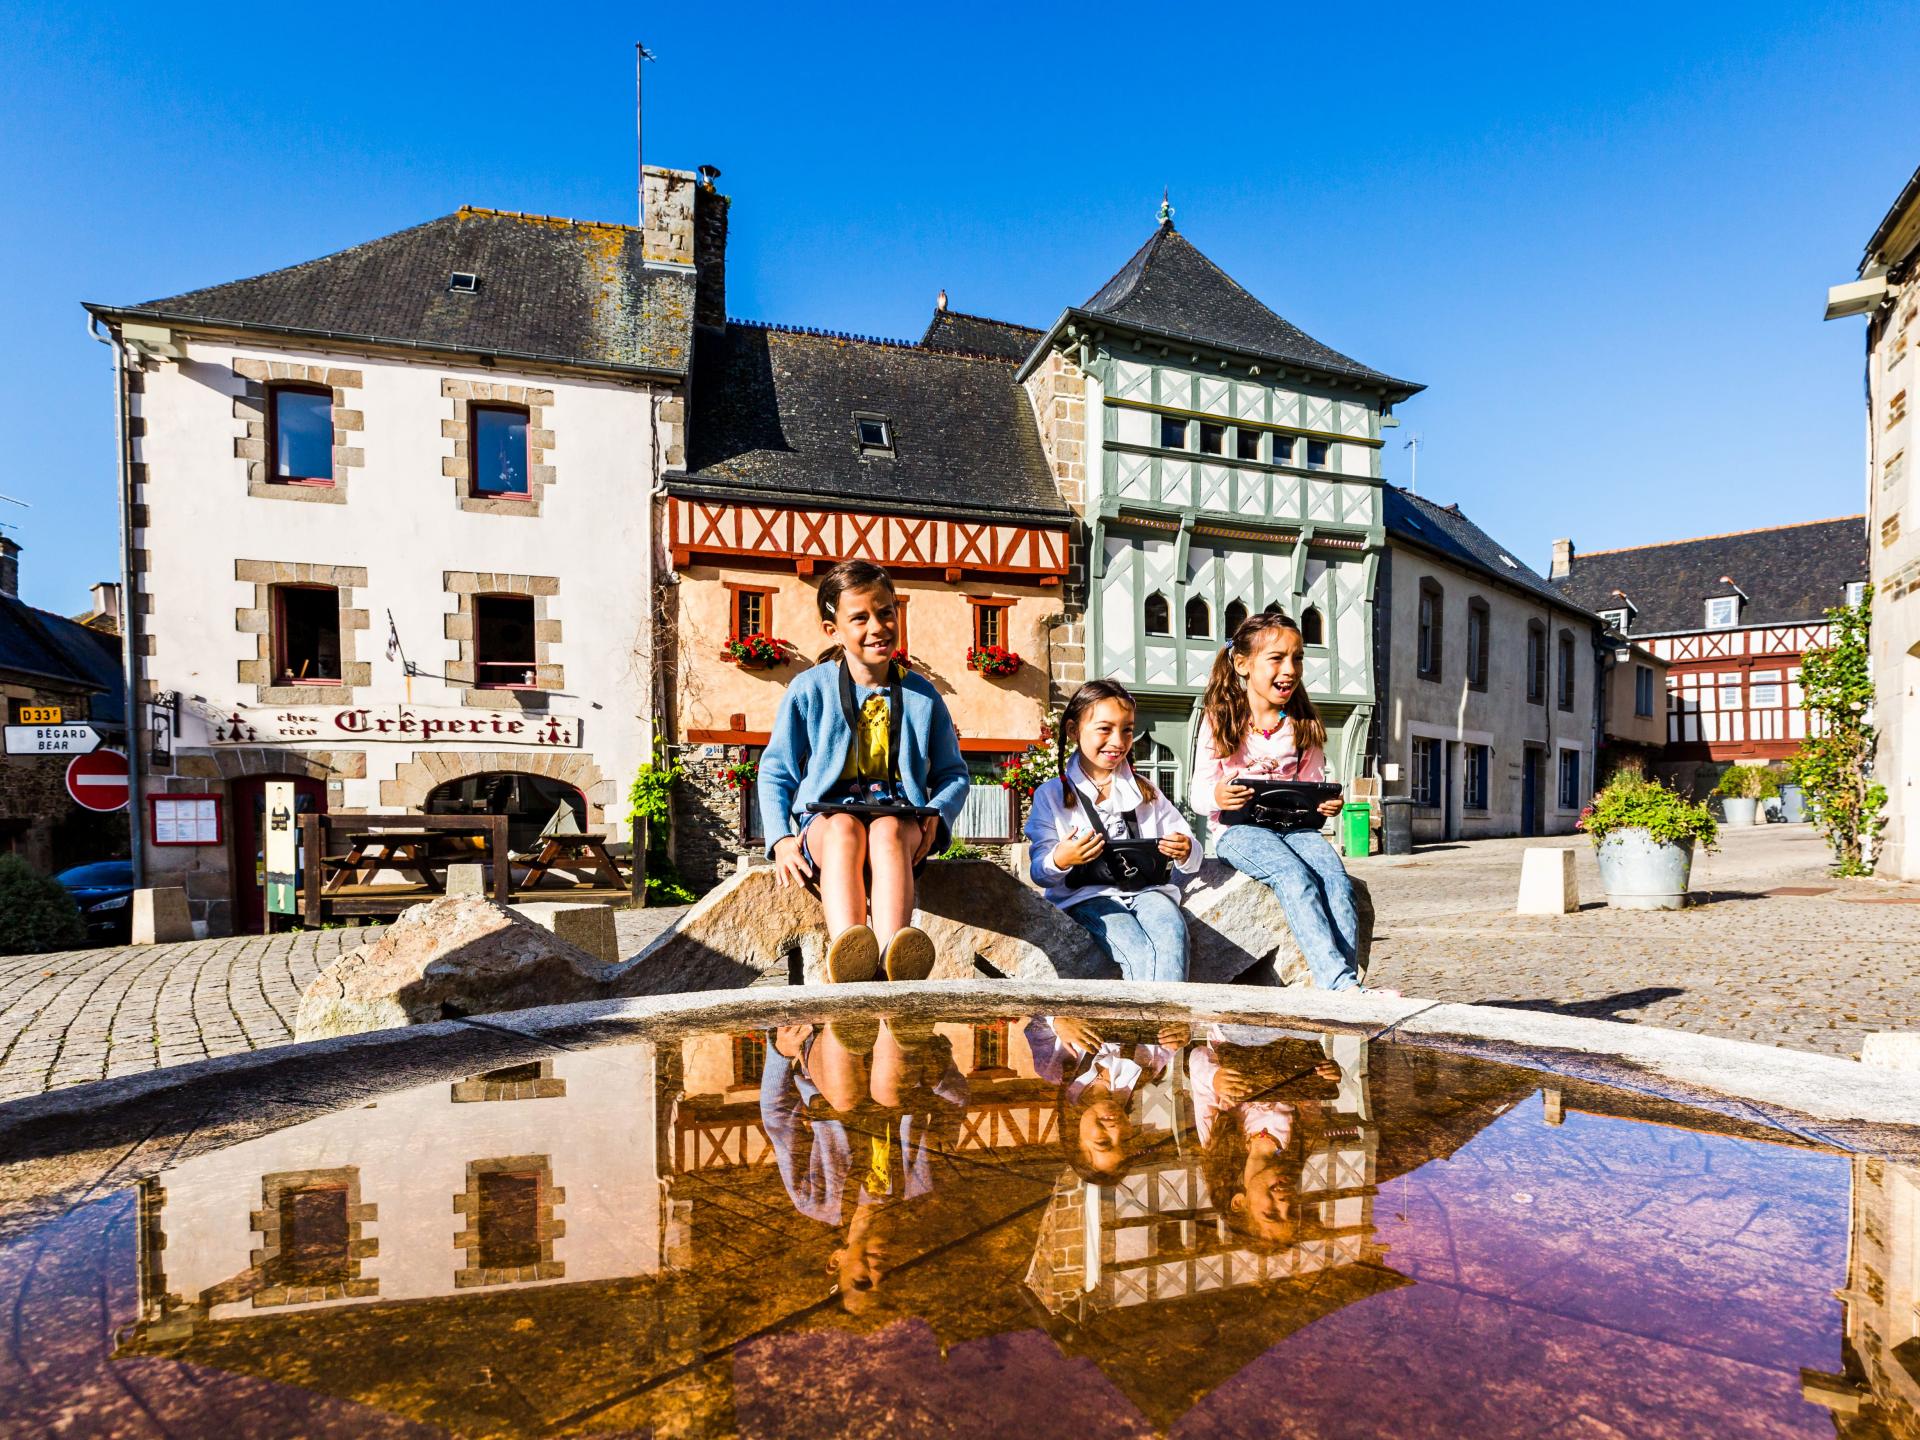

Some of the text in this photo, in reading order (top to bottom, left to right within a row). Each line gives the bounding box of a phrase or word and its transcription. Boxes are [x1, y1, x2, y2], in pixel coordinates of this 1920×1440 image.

[277, 713, 319, 725] chez
[334, 709, 525, 740] Crêperie
[37, 728, 87, 739] BÉGARD
[38, 741, 69, 750] BEAR
